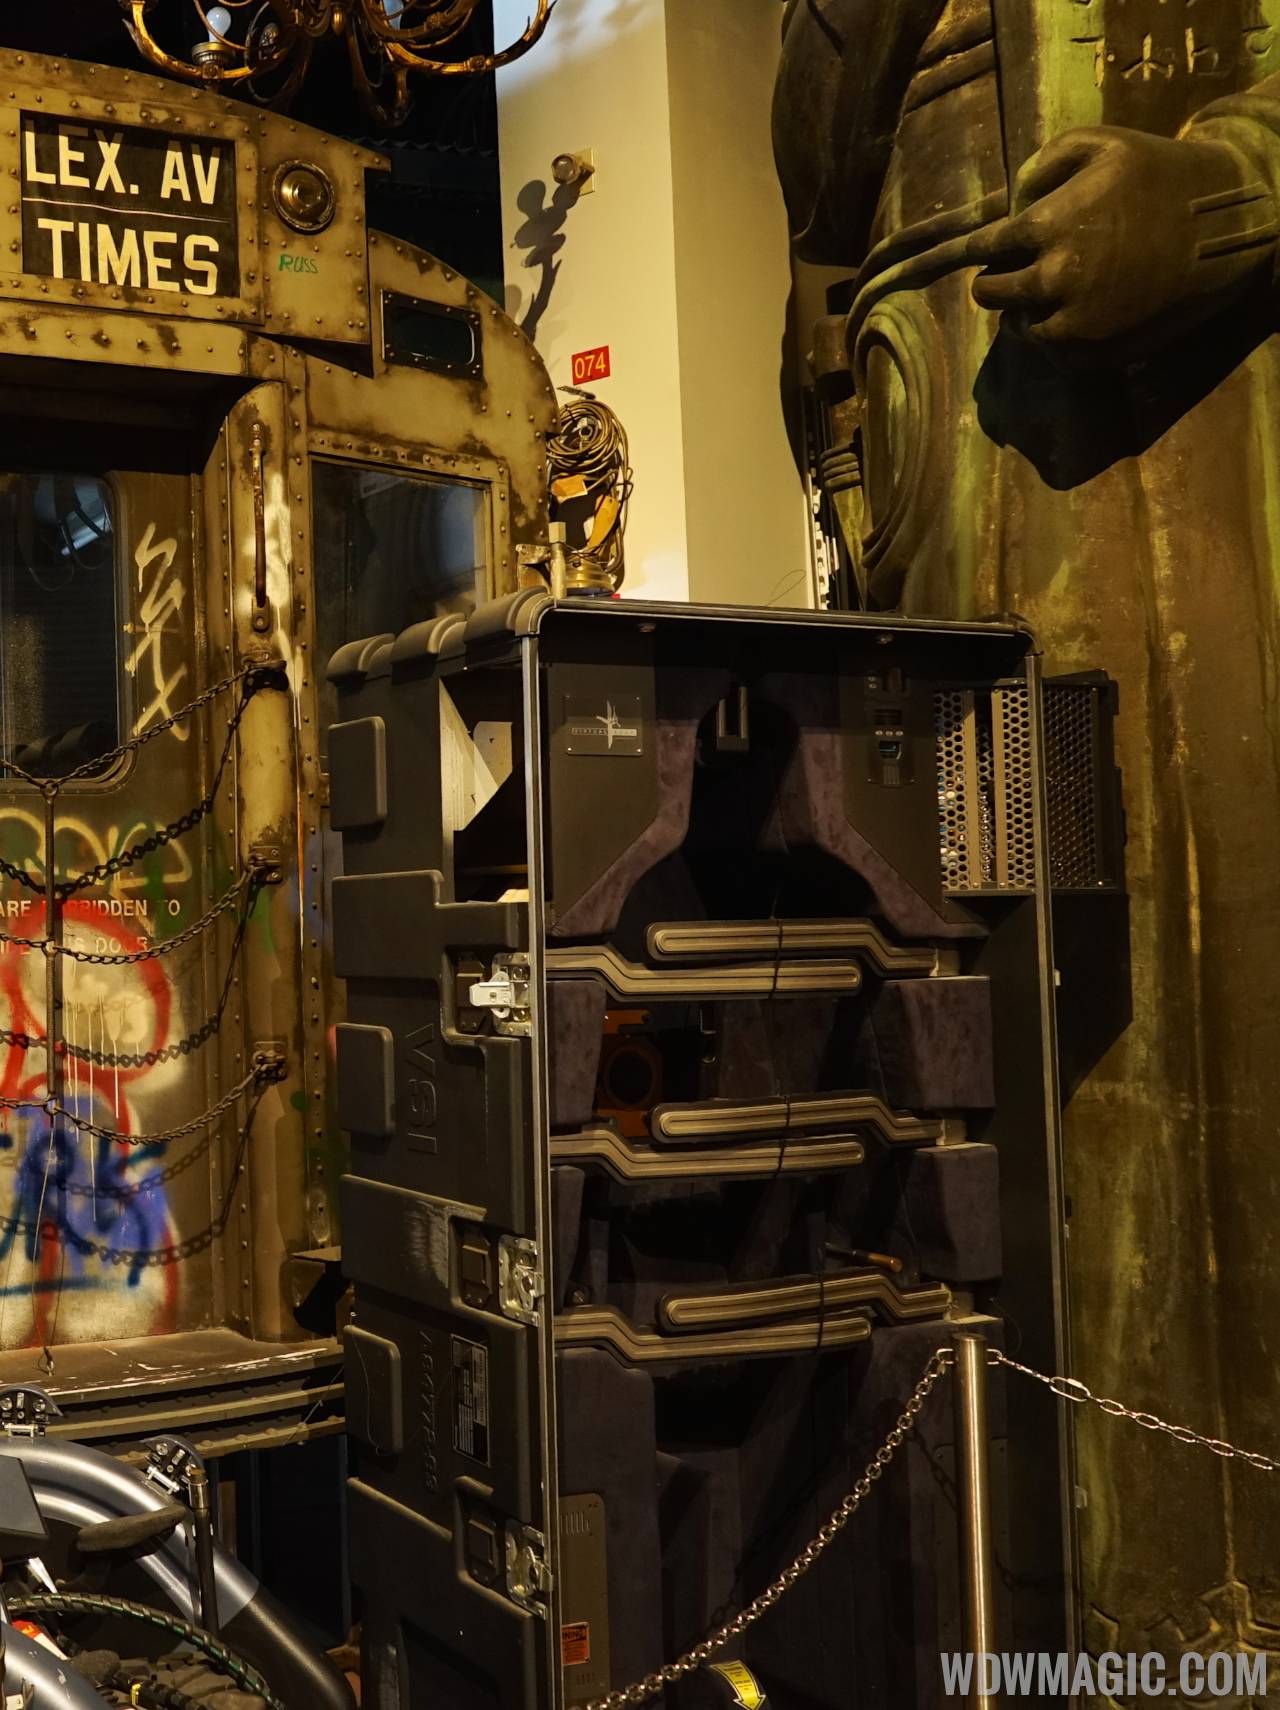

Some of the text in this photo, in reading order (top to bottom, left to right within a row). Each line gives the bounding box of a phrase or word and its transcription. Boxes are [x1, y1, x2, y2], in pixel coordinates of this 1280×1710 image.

[24, 118, 220, 205] LEX. AV
[37, 217, 219, 297] TIMES
[574, 351, 607, 379] 074
